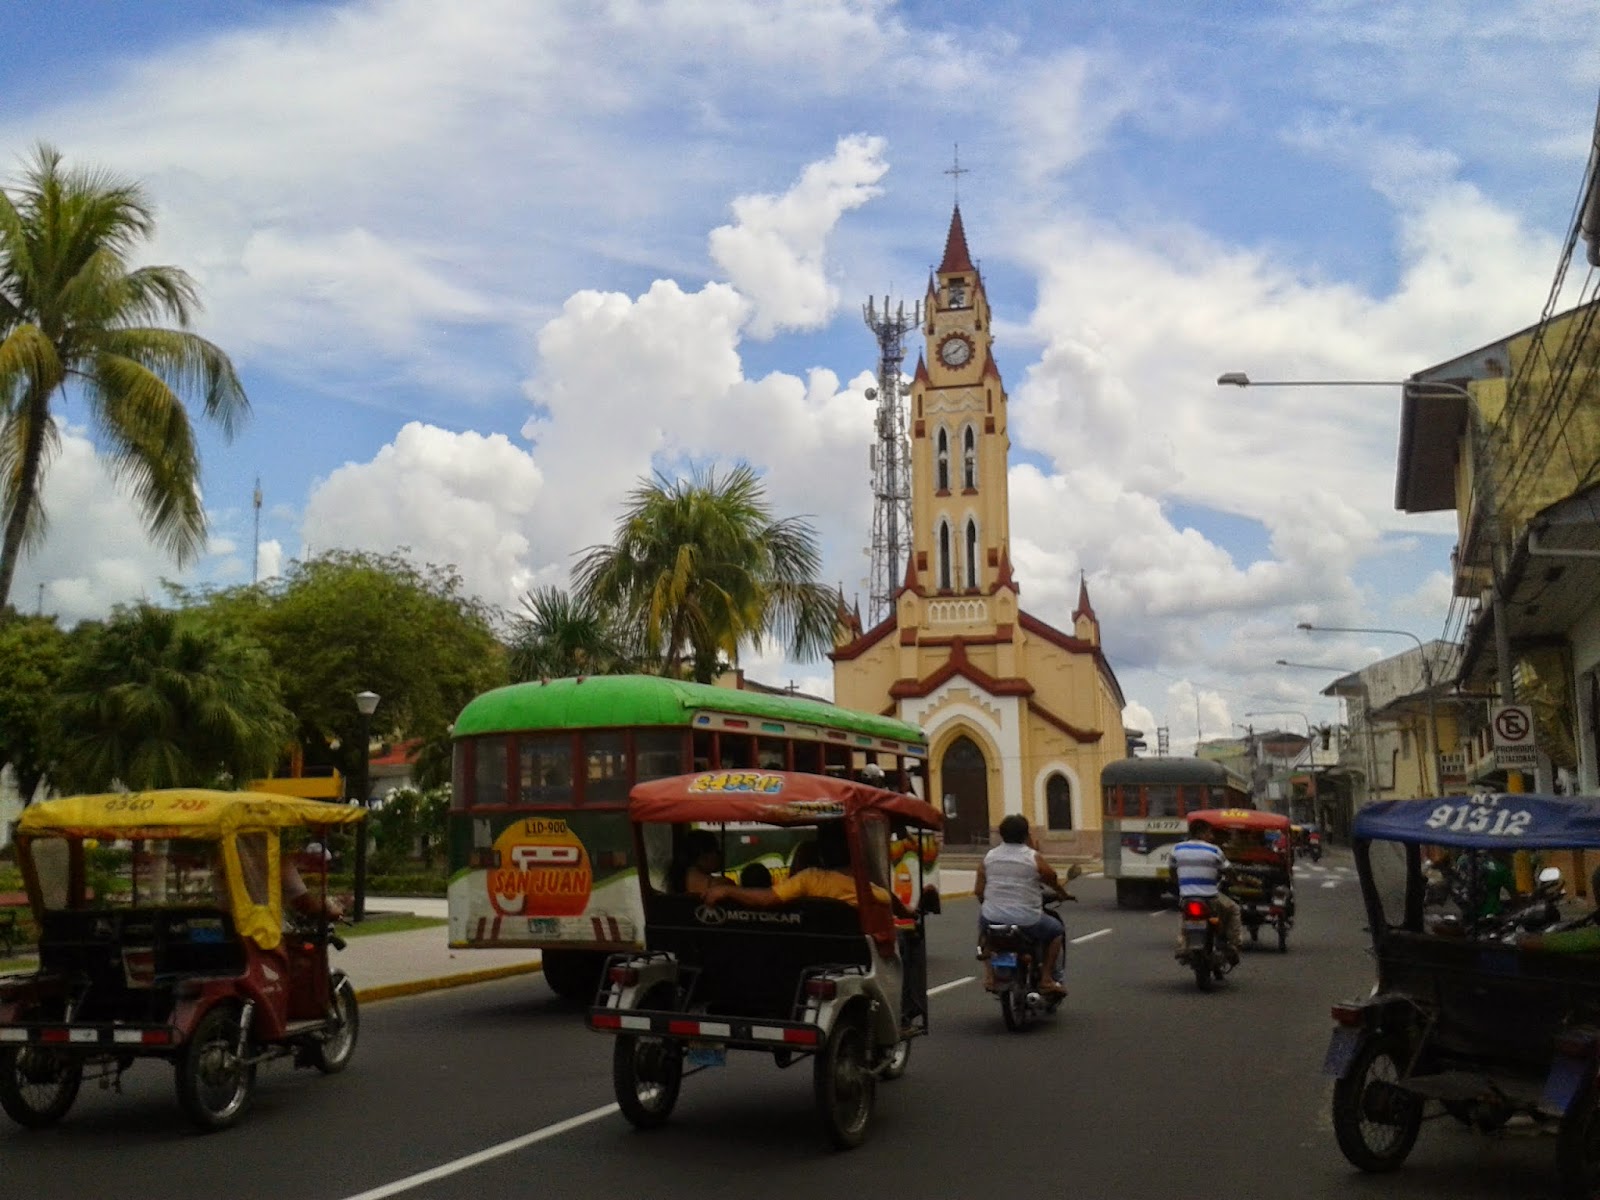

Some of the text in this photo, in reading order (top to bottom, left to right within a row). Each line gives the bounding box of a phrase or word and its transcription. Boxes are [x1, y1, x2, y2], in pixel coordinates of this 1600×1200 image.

[495, 869, 590, 896] SAN JUAN
[727, 910, 800, 923] MOTOKAR
